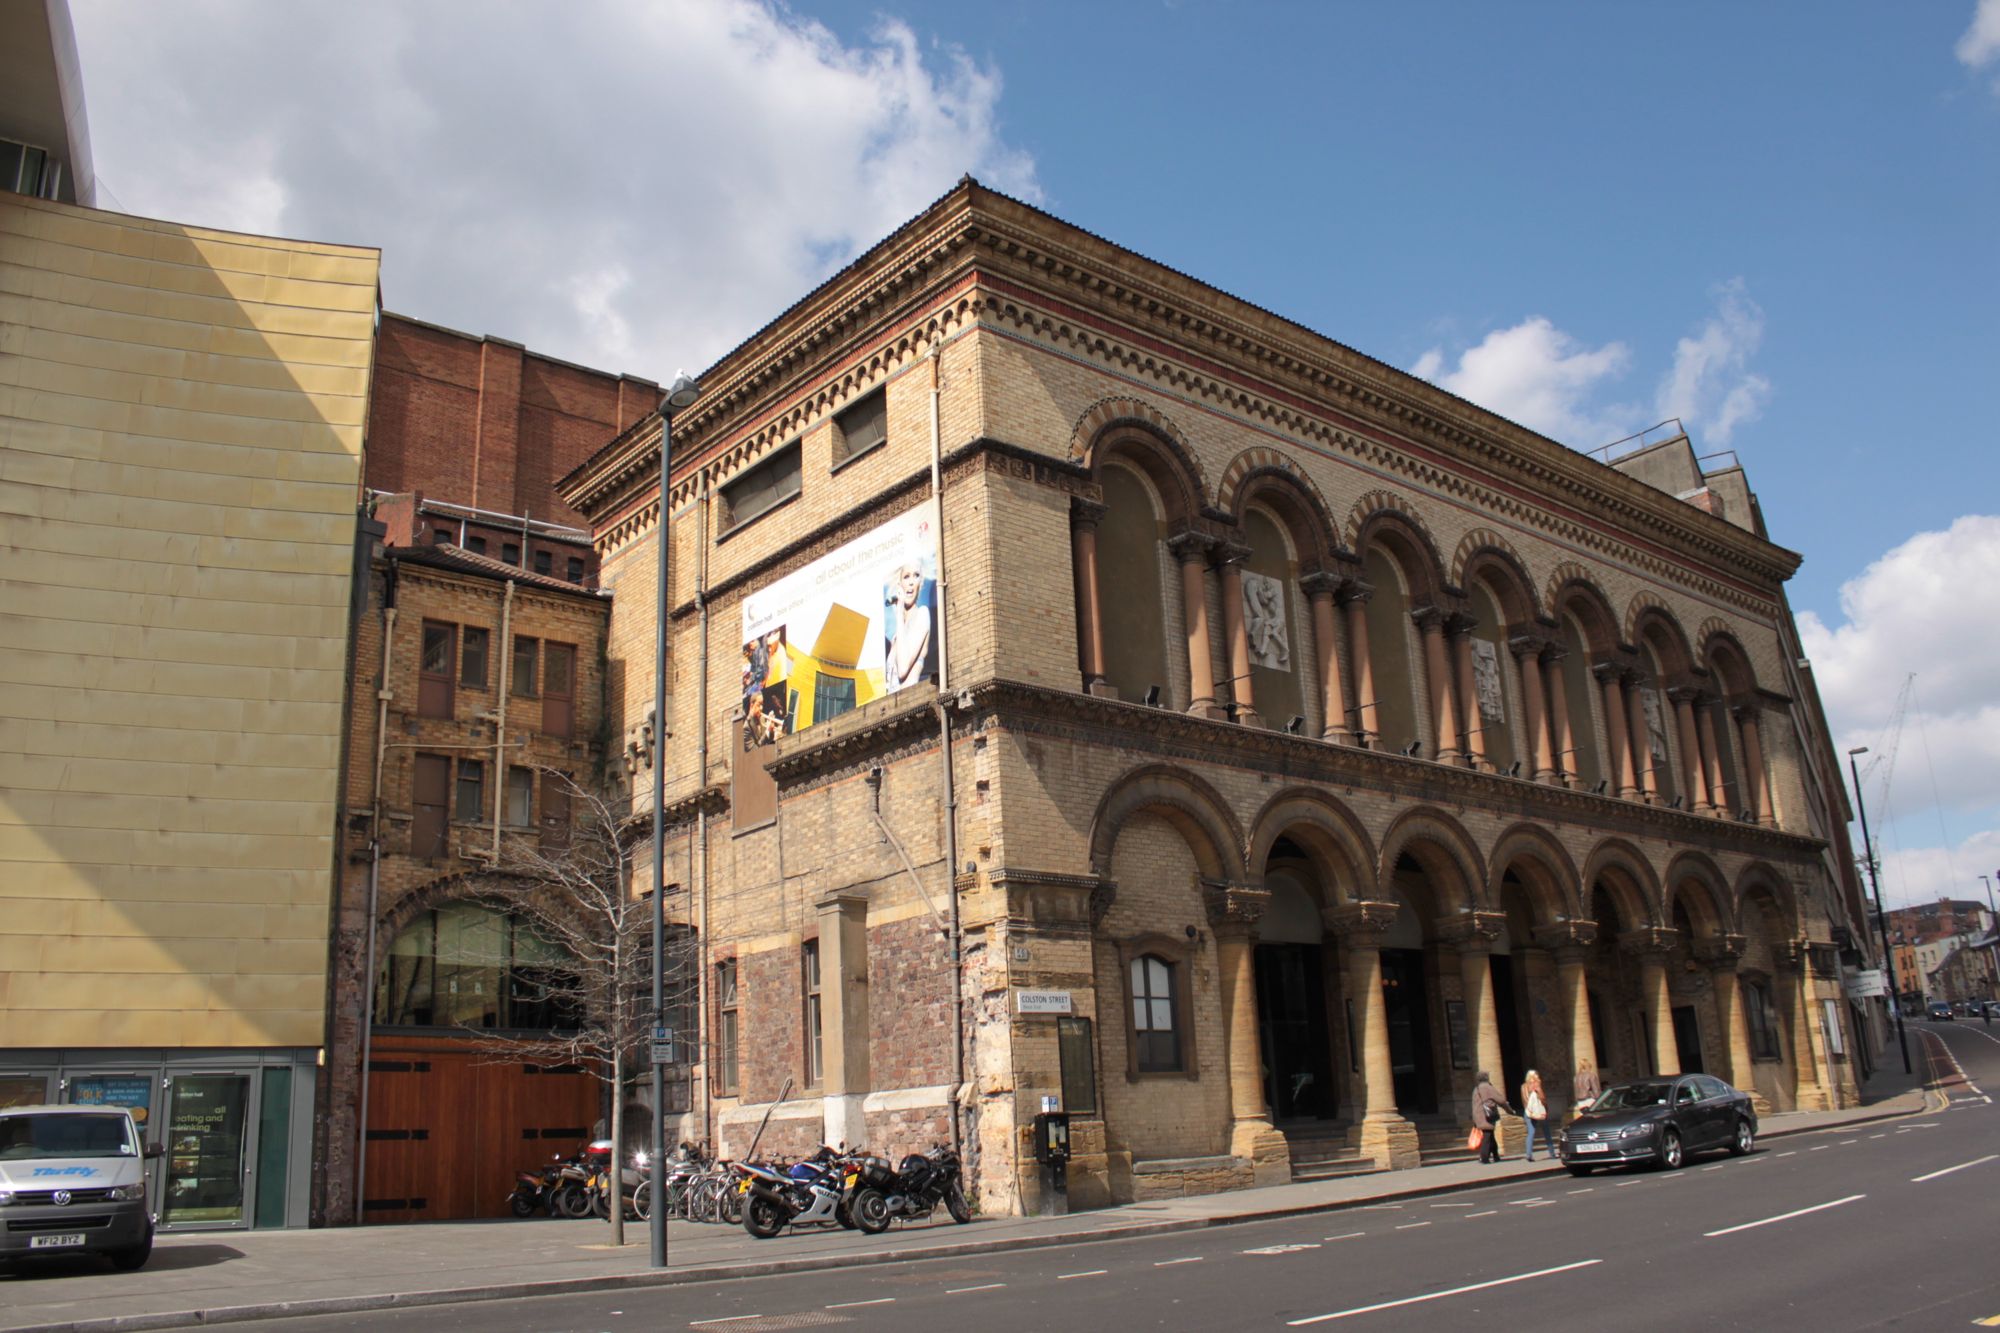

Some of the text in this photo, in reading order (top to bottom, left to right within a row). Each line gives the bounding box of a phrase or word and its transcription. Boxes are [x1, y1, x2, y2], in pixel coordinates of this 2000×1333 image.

[815, 571, 827, 585] all
[828, 556, 855, 578] about
[858, 547, 874, 563] the
[874, 532, 905, 555] music
[1021, 995, 1068, 1004] COLSTON STREET
[214, 1106, 226, 1114] all
[205, 1114, 223, 1122] and
[37, 1234, 80, 1246] WF12 BYZ
